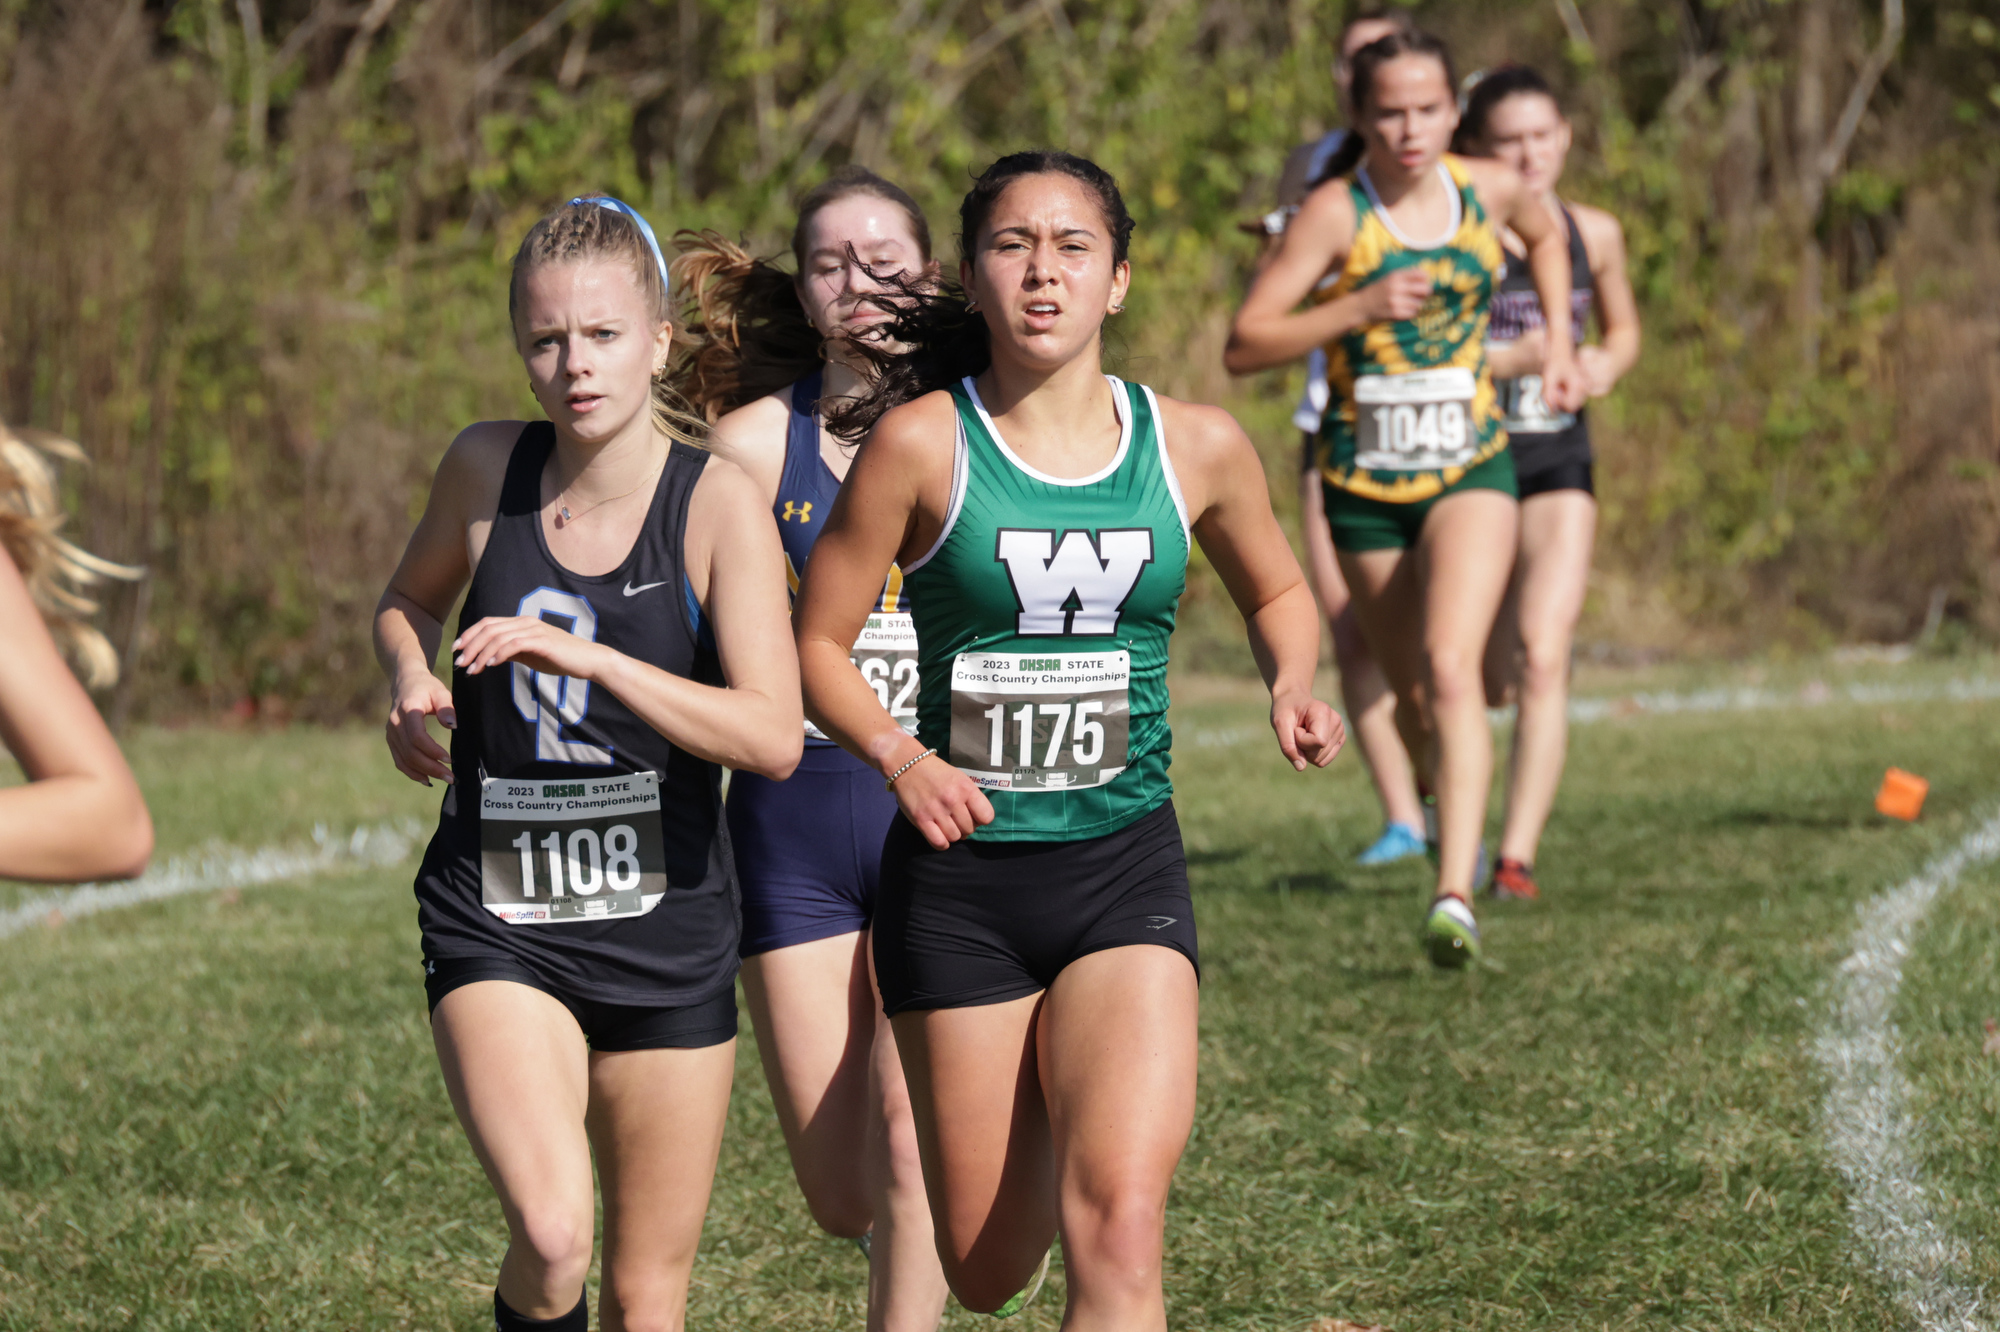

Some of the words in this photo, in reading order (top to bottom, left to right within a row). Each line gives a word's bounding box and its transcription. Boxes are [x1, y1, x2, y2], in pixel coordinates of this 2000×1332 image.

[1372, 401, 1466, 452] 1049
[994, 527, 1154, 637] W
[888, 620, 912, 628] STAT
[864, 632, 917, 641] Champion
[982, 660, 1010, 670] 2023
[1019, 659, 1061, 671] OHSAA
[1067, 660, 1104, 669] STATE
[956, 671, 989, 682] Cross
[991, 673, 1038, 685] Country
[1041, 672, 1127, 684] Championships
[850, 657, 920, 717] 62
[984, 701, 1104, 767] 1175
[970, 776, 998, 786] ileSplit
[507, 787, 535, 796] 2023
[542, 784, 586, 798] OHSAA
[592, 782, 631, 794] STATE
[484, 799, 514, 810] Cross
[517, 801, 563, 811] Country
[566, 793, 657, 810] Championships
[512, 824, 641, 898] 1108
[550, 897, 572, 905] 01108
[499, 911, 534, 920] MileSplit
